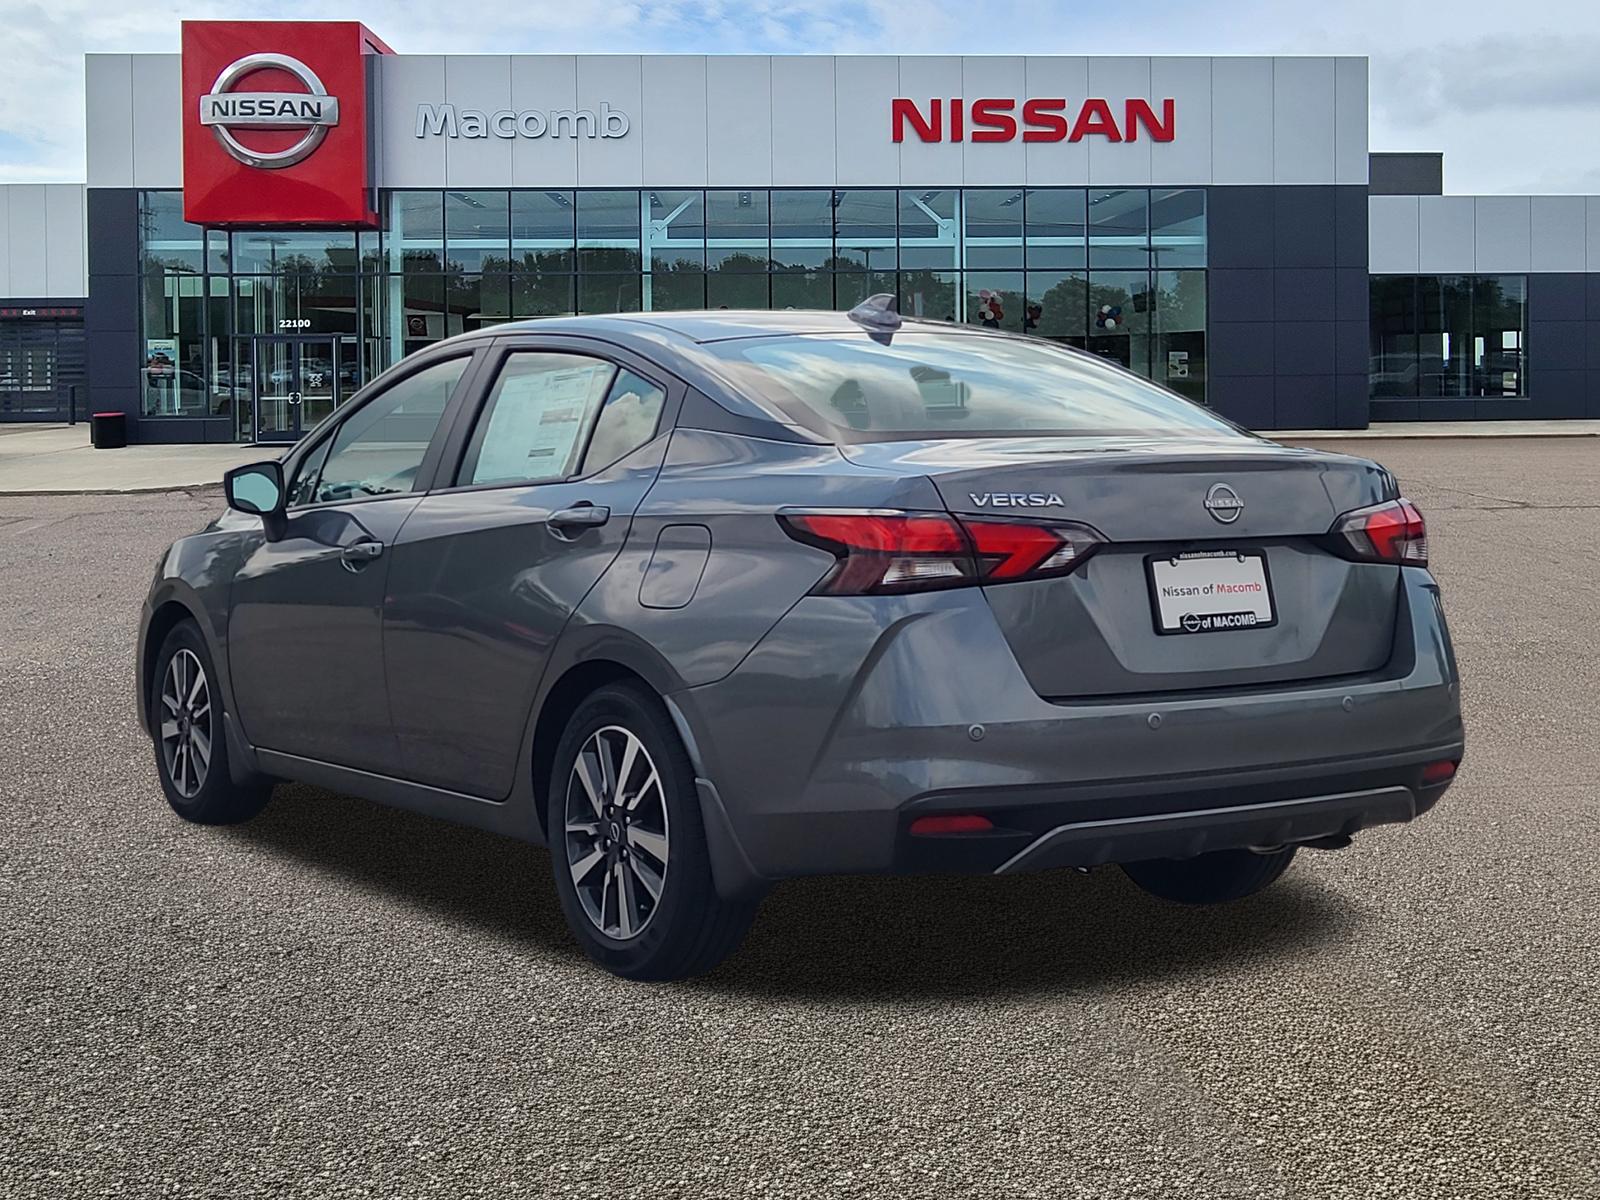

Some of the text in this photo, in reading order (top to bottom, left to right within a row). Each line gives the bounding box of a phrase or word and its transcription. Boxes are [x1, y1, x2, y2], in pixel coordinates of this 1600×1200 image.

[211, 99, 322, 118] NISSAN
[415, 101, 631, 139] Macomb
[891, 98, 1176, 143] NISSAN
[279, 319, 311, 328] 22100
[968, 492, 1065, 508] VERSA
[1204, 498, 1244, 508] NISSAN
[1162, 582, 1262, 597] Nissan of Macomb
[1202, 614, 1257, 629] of MACOMB
